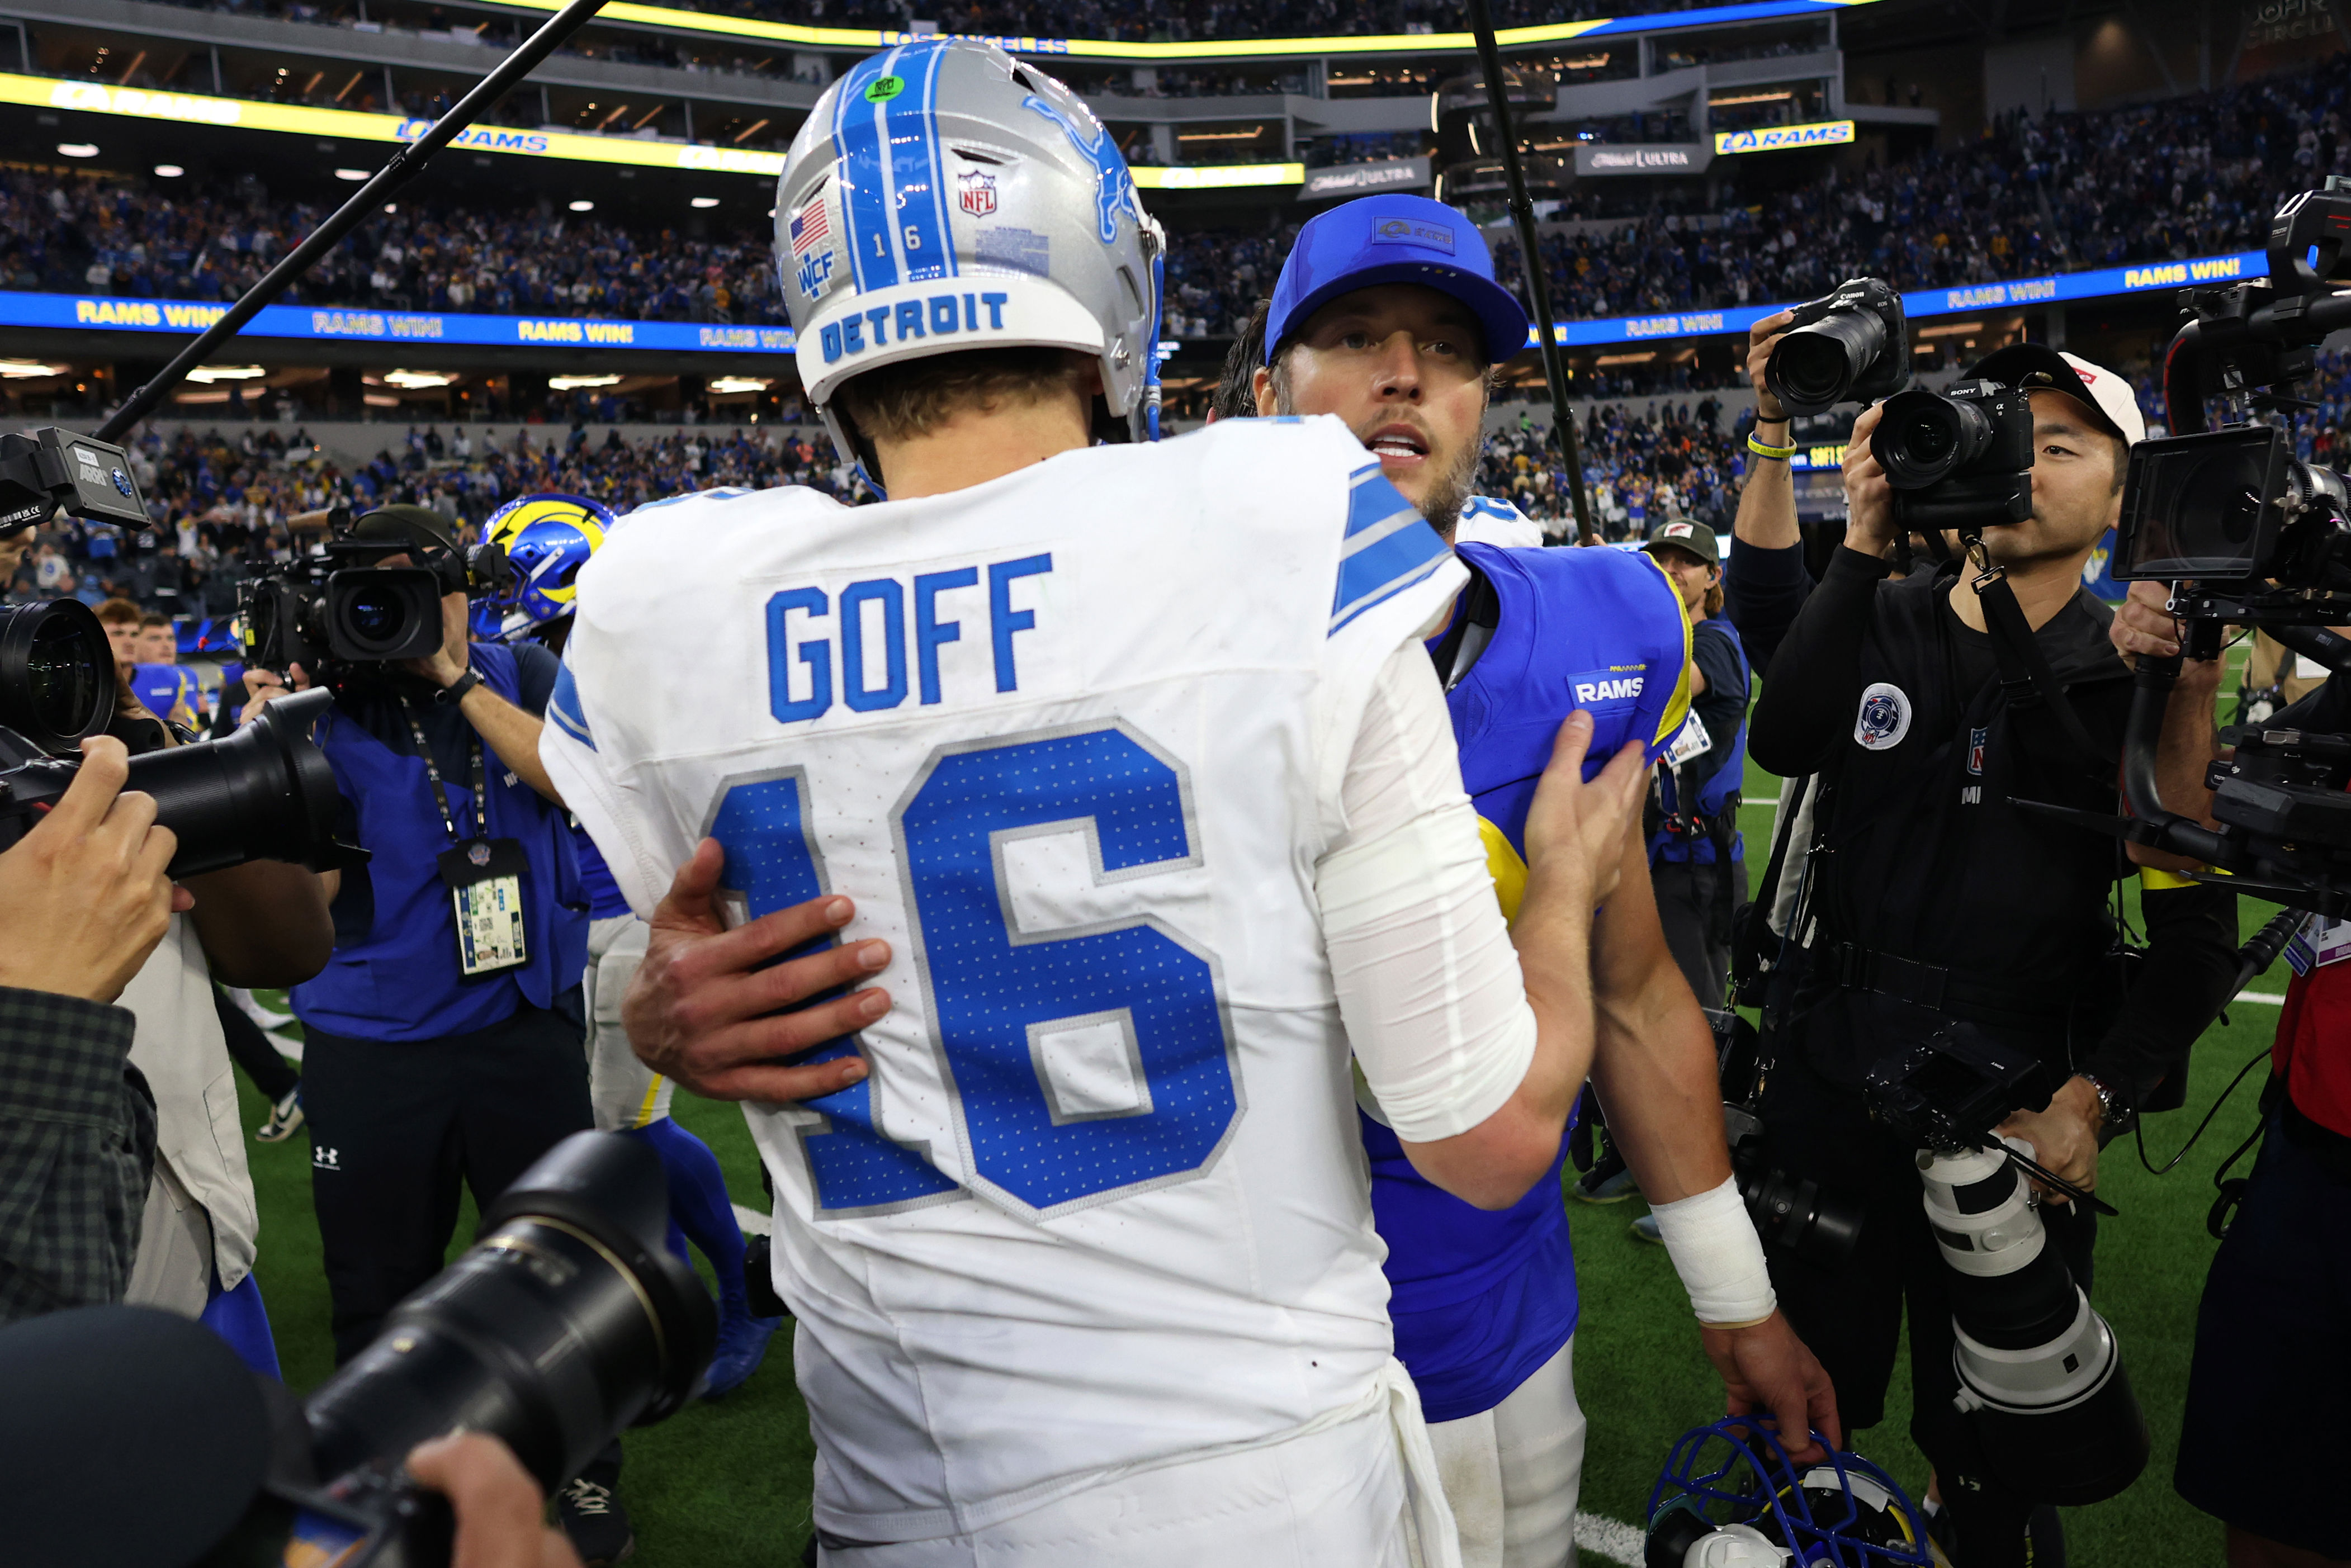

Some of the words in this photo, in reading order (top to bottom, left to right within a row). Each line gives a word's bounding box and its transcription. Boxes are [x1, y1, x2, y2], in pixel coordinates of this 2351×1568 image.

[1763, 125, 1849, 146] RAMS
[1644, 151, 1689, 166] ULTRA
[1368, 167, 1415, 184] ULTRA
[964, 190, 994, 212] NFL
[795, 250, 834, 295] WCF
[2125, 264, 2187, 288] RAMS
[2190, 257, 2241, 281] WIN!
[1840, 291, 1865, 300] Canon
[1948, 286, 2007, 309] RAMS
[2010, 279, 2056, 302] WIN!
[77, 300, 161, 326] RAMS
[312, 311, 385, 336] RAMS
[387, 315, 443, 338] WIN!
[1626, 316, 1679, 337] RAMS
[1681, 313, 1724, 333] WIN!
[518, 321, 583, 342] RAMS
[584, 323, 633, 343] WIN!
[699, 327, 758, 348] RAMS
[819, 292, 1008, 364] DETROIT
[1950, 387, 1977, 396] SONY
[79, 463, 107, 487] ARRI
[765, 551, 1053, 724] GOFF
[1575, 676, 1644, 704] RAMS
[1863, 732, 1875, 743] NFL
[698, 716, 1250, 1224] 16
